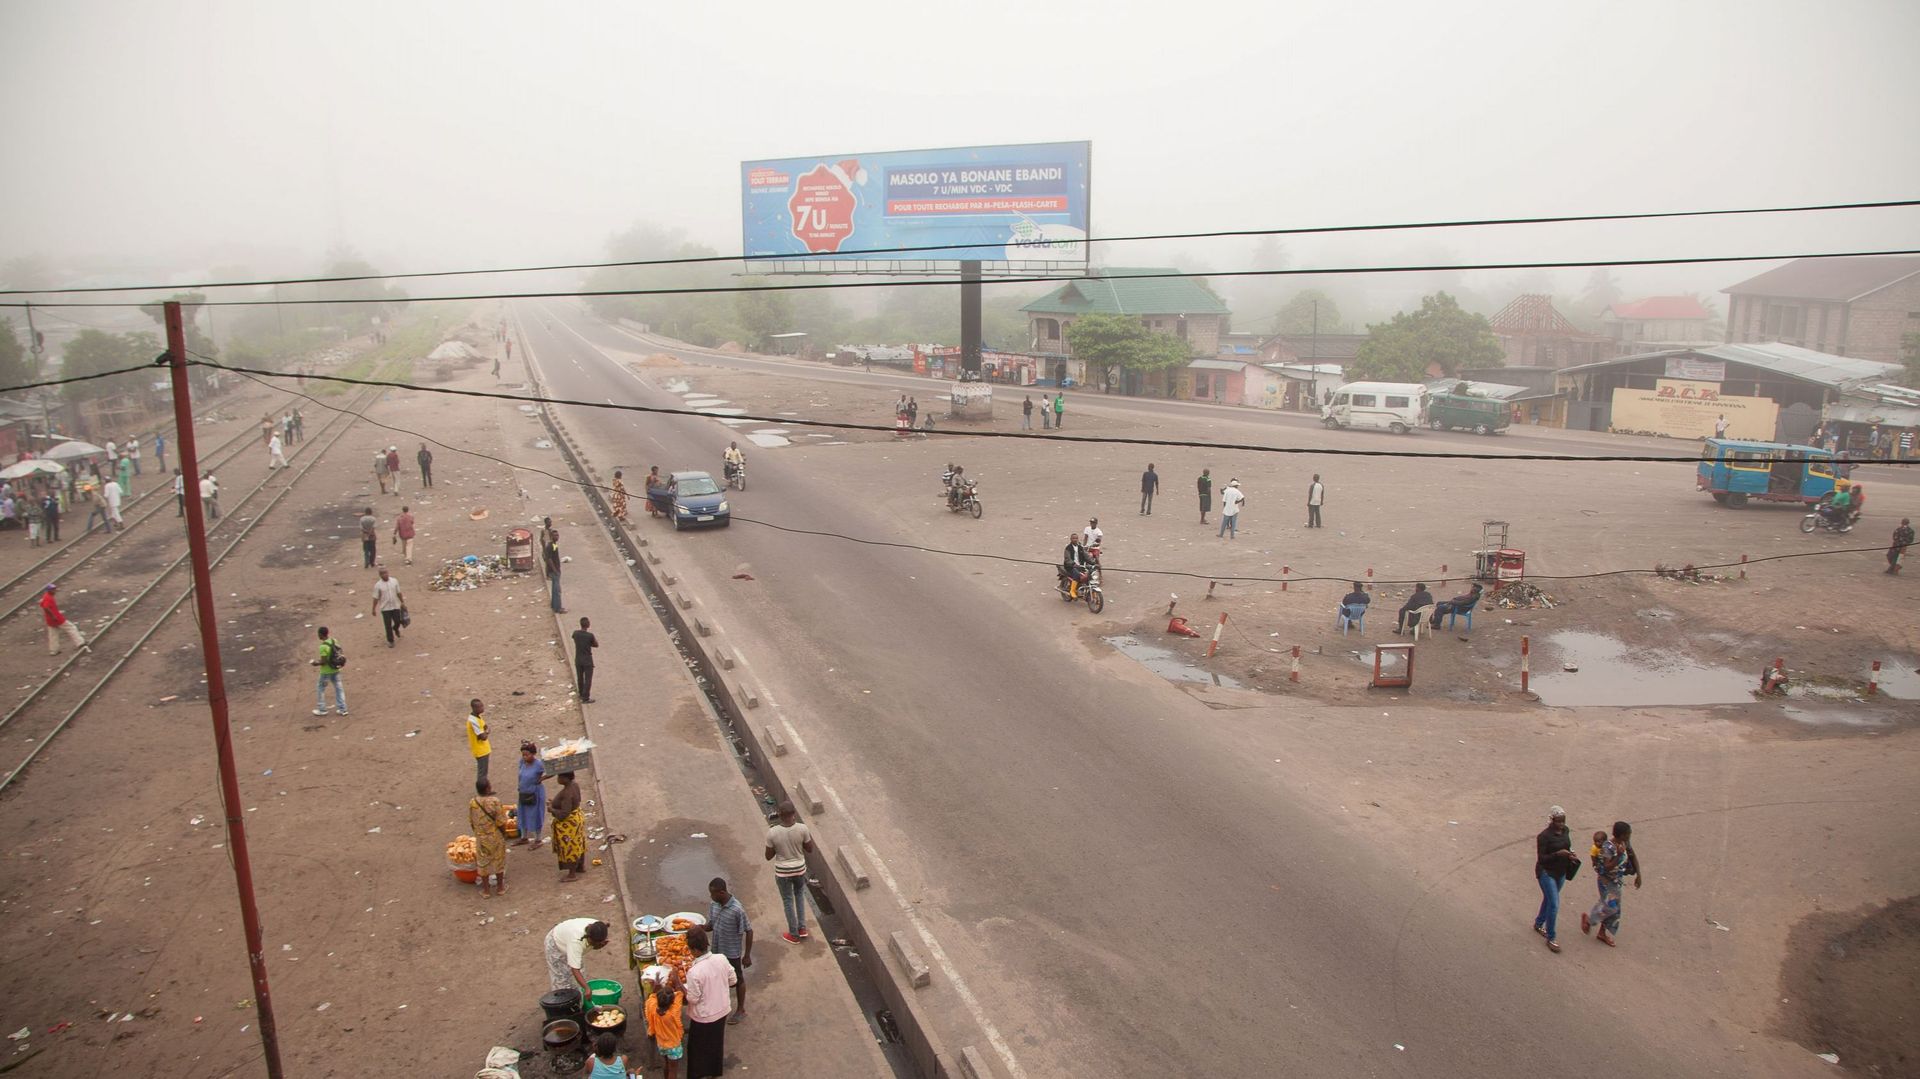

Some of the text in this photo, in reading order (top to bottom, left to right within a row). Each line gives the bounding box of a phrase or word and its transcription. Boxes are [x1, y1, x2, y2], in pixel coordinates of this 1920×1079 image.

[890, 167, 1062, 187] MASOLO YA BONANE EBANDI
[933, 186, 939, 195] 7
[941, 185, 968, 195] U/MIN
[970, 184, 987, 194] VDC
[995, 183, 1013, 193] VDC
[894, 203, 912, 212] POUR
[913, 203, 934, 211] TOUTE
[934, 202, 969, 211] RECHARGE
[970, 201, 983, 210] PAR
[1015, 233, 1078, 249] vodacom
